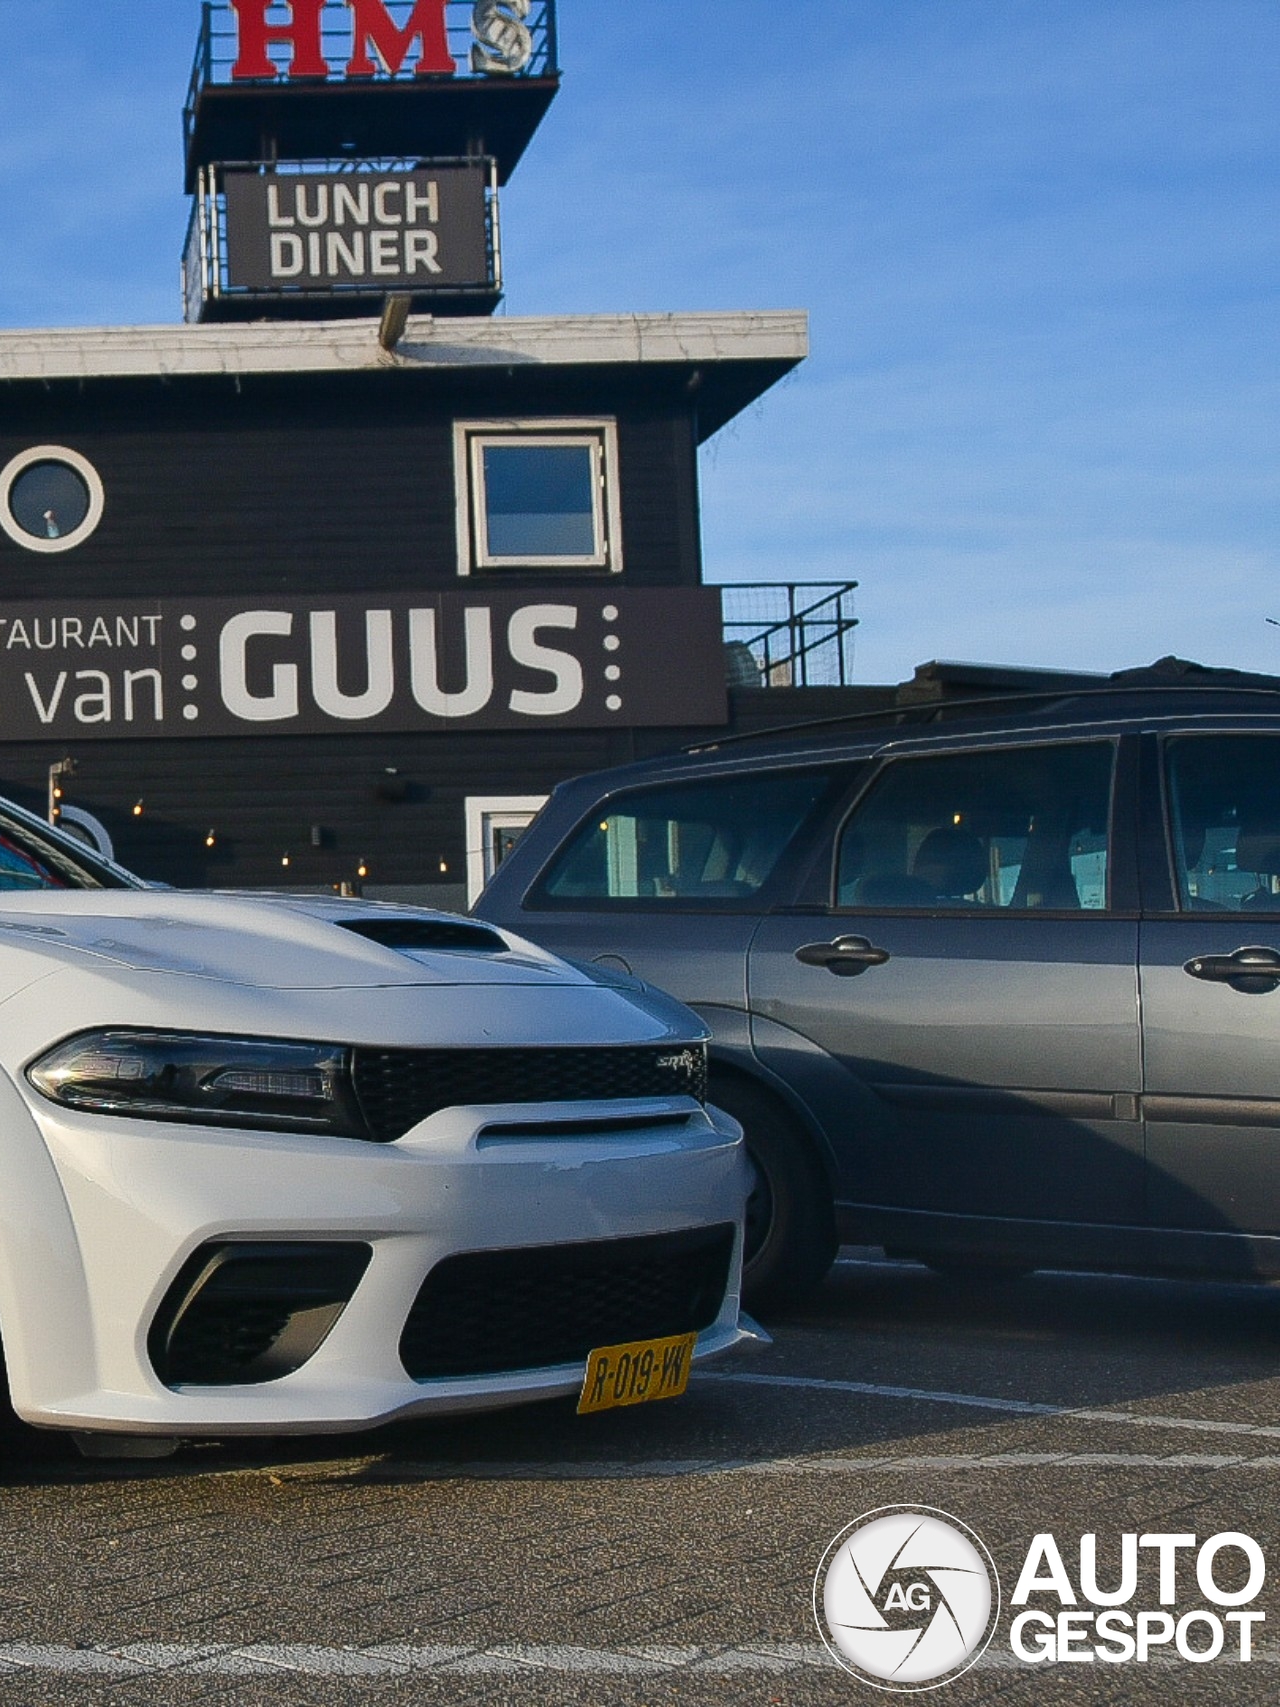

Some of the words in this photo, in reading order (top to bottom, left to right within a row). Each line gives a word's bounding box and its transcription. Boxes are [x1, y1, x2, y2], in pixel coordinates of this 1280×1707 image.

[231, 0, 532, 78] HMS
[268, 182, 438, 226] LUNCH
[271, 230, 441, 276] DINER
[220, 604, 583, 721] GUUS
[25, 669, 163, 723] van
